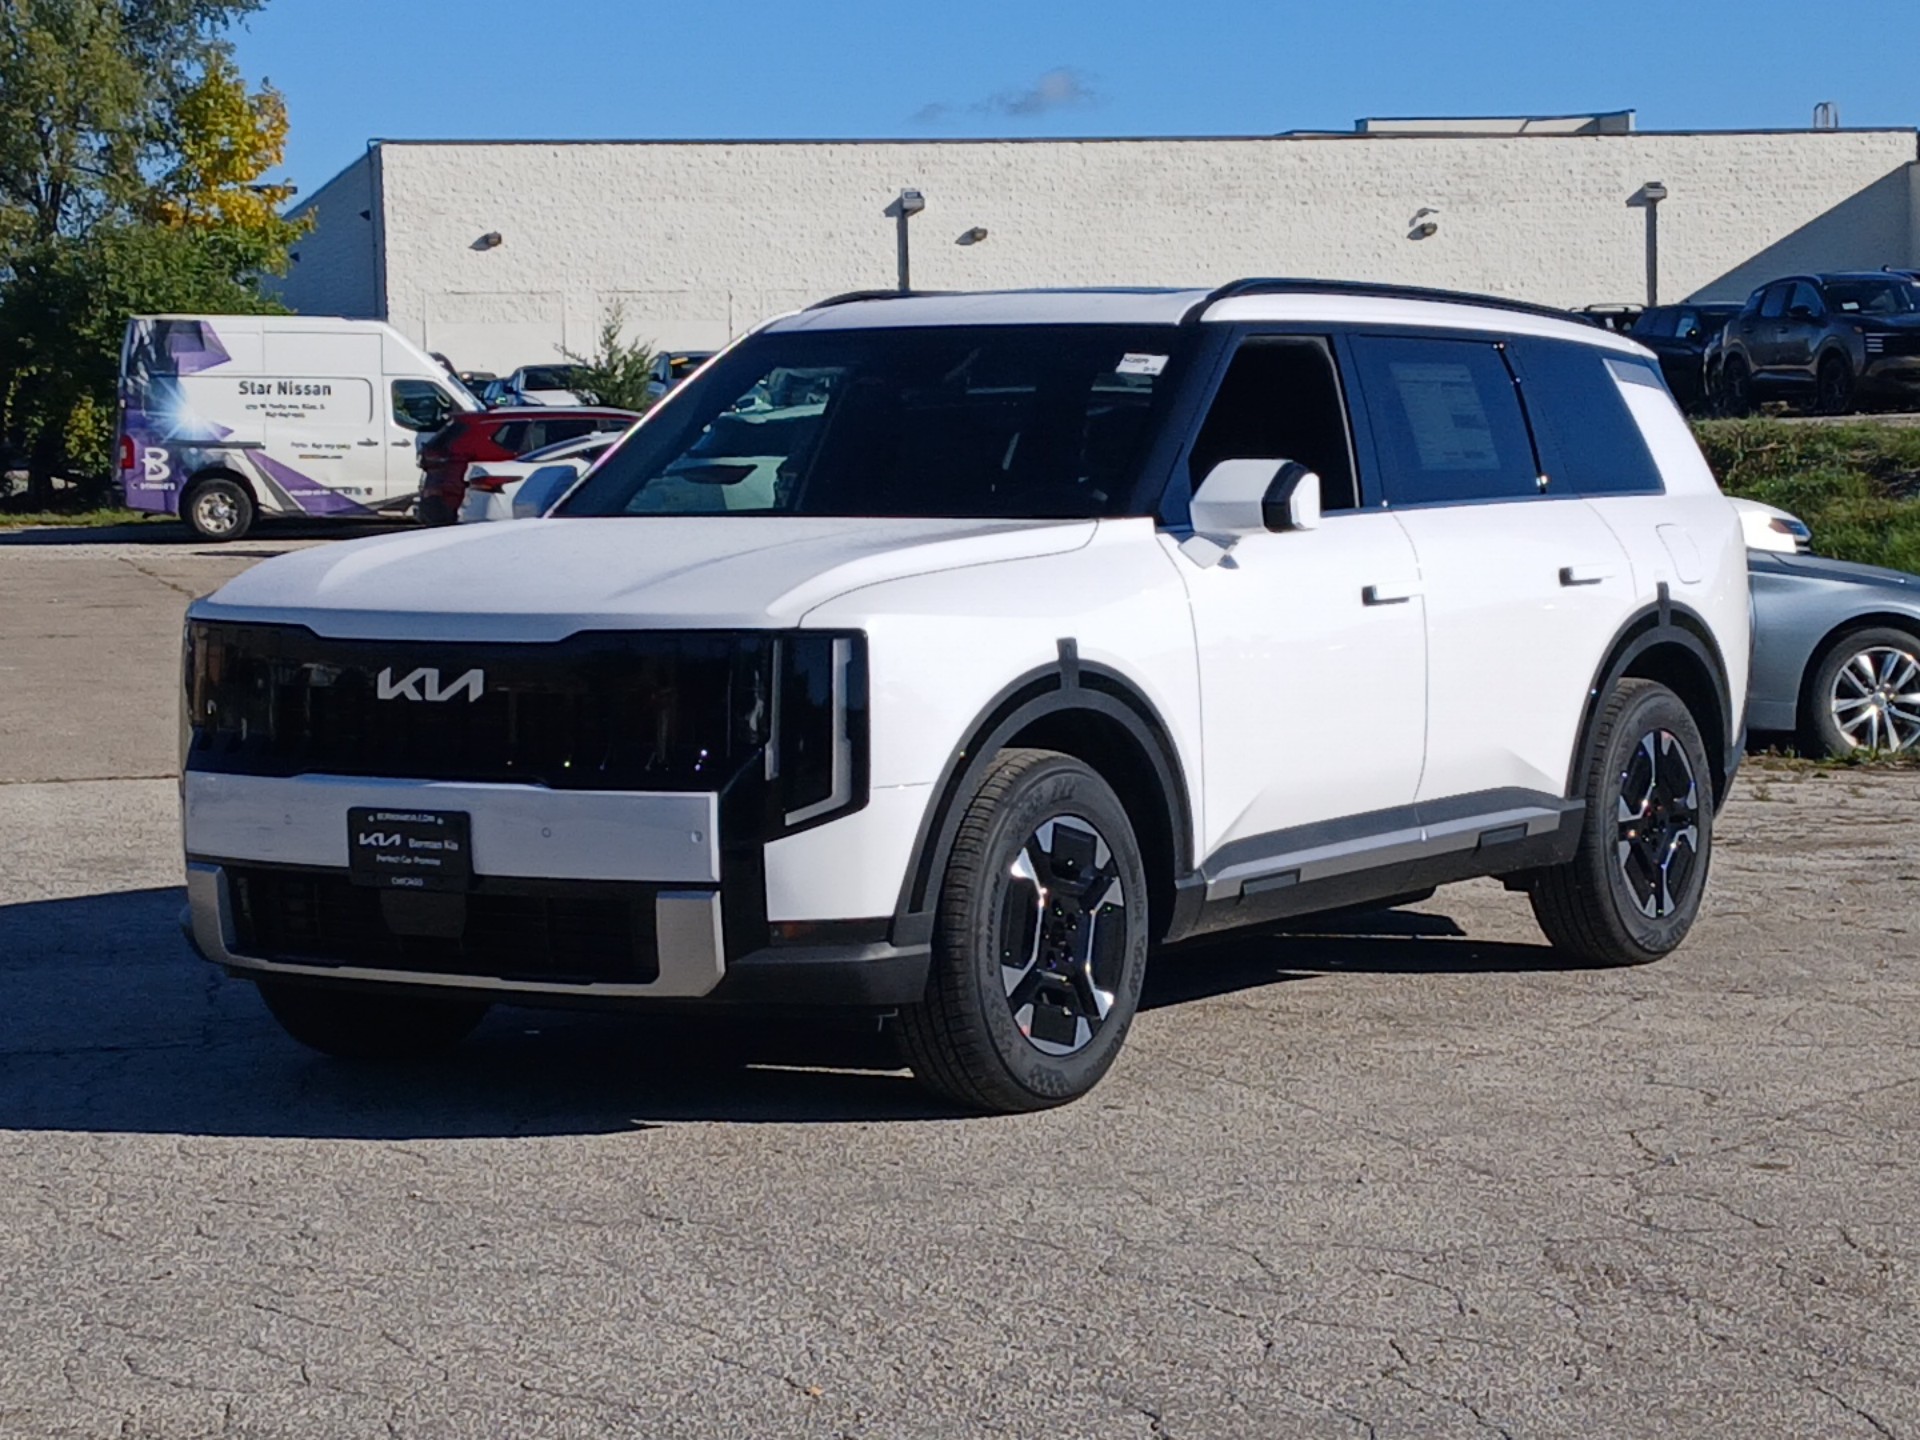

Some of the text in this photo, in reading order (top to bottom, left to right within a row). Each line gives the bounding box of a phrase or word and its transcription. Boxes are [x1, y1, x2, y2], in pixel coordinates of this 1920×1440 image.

[238, 380, 332, 396] Star Nissan
[377, 666, 484, 702] KIA
[359, 832, 401, 847] KIA
